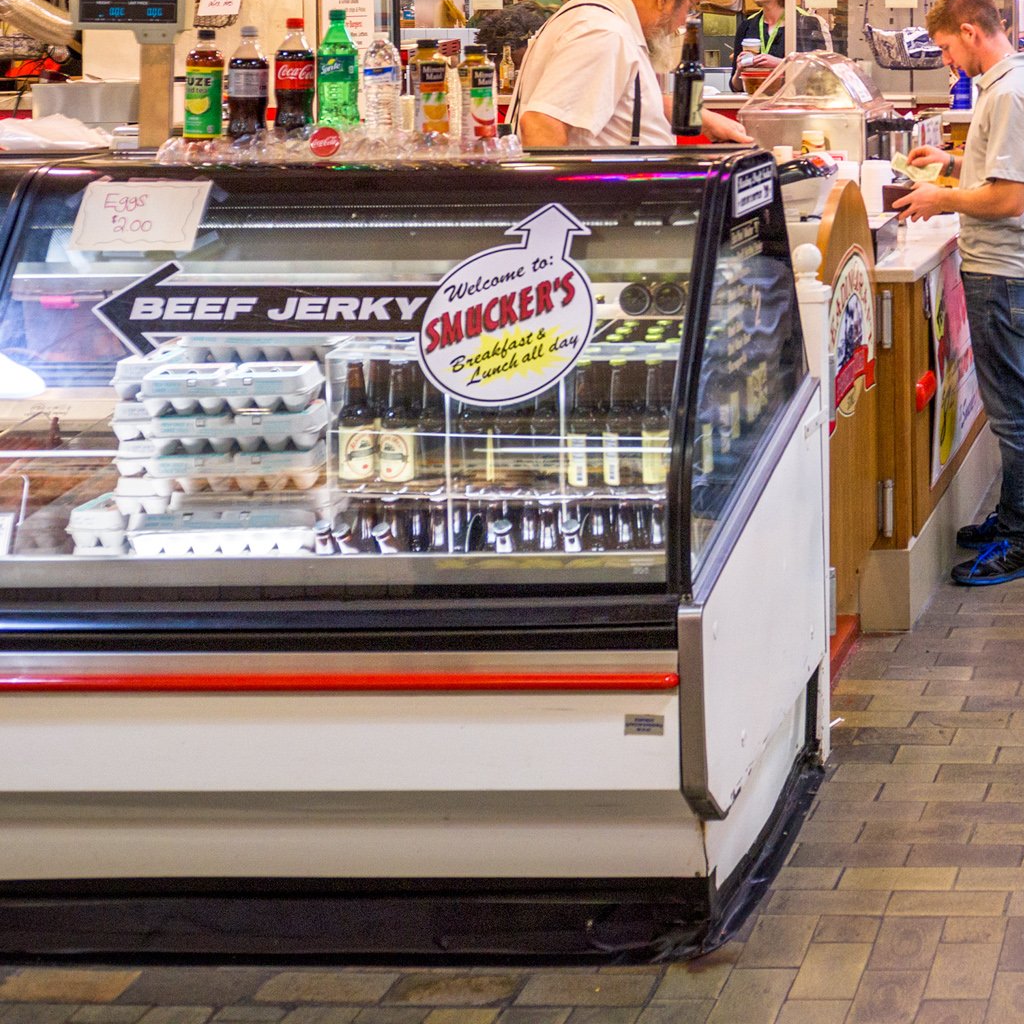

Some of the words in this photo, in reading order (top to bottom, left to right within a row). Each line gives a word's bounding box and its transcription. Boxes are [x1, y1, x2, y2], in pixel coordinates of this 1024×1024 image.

[103, 192, 149, 212] Eggs
[111, 215, 153, 233] $2.00
[443, 264, 526, 303] Welcome
[531, 255, 555, 272] to:
[129, 296, 259, 321] BEEF
[267, 296, 427, 321] JERKY
[425, 270, 576, 354] SMUCKER'S
[450, 330, 533, 373] Breakfast
[537, 327, 546, 340] &
[466, 359, 519, 387] Lunch
[521, 343, 544, 364] all
[548, 333, 580, 352] day
